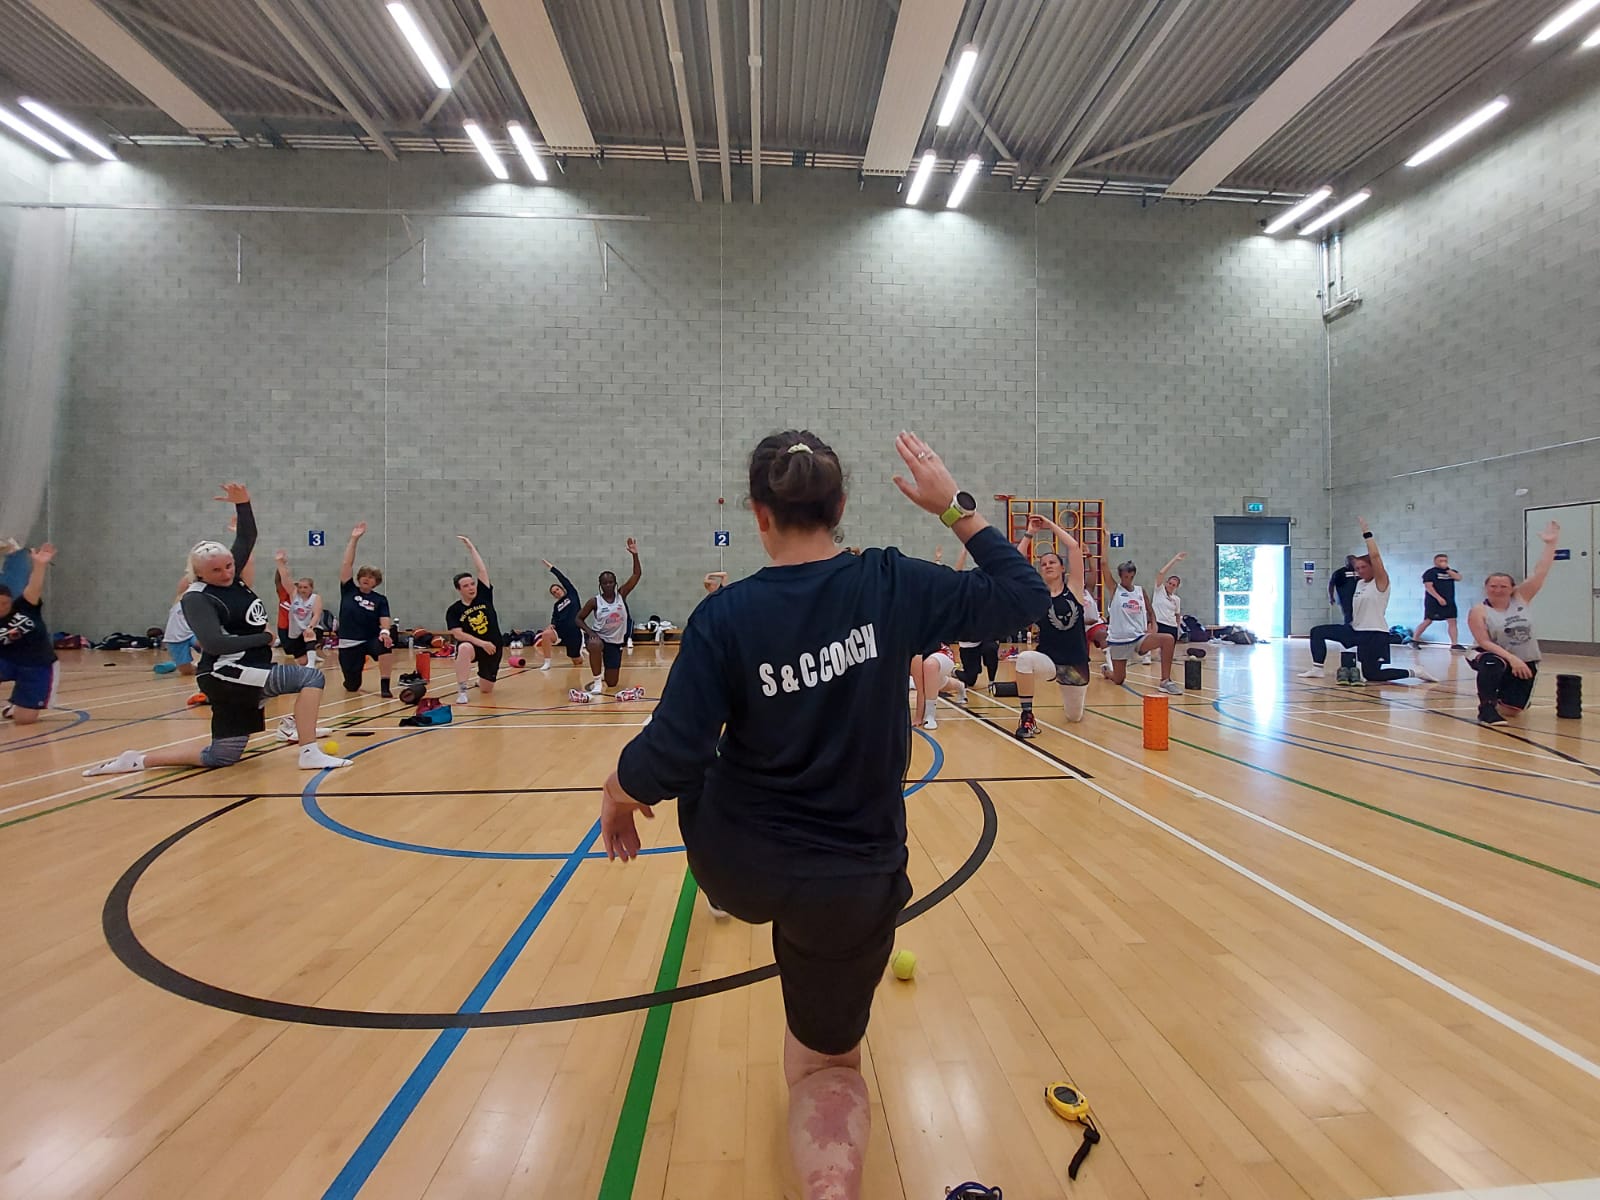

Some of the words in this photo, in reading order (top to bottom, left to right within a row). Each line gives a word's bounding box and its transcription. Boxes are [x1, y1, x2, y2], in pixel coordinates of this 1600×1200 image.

[312, 535, 321, 545] 3
[718, 535, 726, 545] 2
[1113, 536, 1119, 546] 1
[759, 662, 778, 697] S
[780, 664, 800, 693] &
[799, 652, 818, 688] C
[819, 623, 878, 682] COACH
